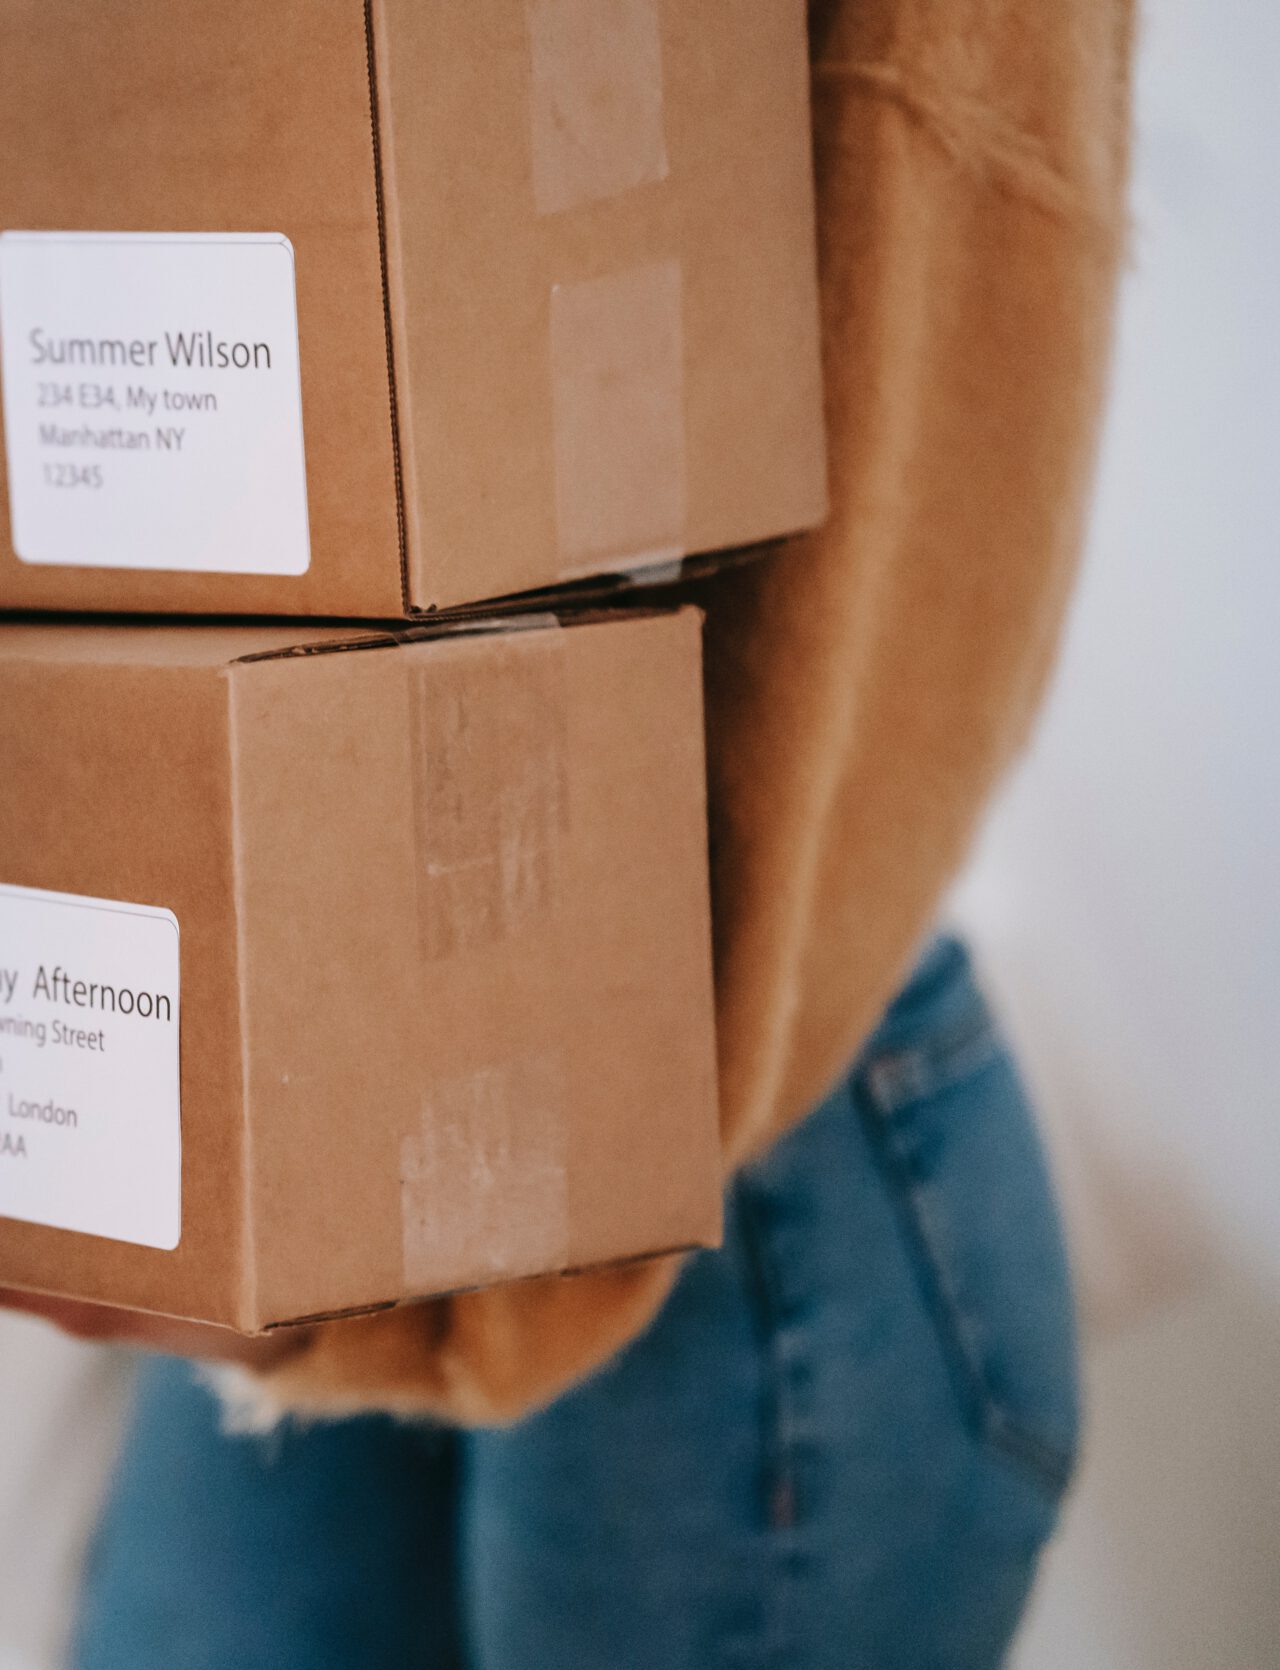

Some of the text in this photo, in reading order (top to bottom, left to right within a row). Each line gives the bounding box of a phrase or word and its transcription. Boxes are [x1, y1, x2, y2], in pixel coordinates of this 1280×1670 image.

[29, 327, 271, 368] Summer Wilson
[37, 383, 72, 408] 234
[127, 386, 157, 416] My
[163, 391, 218, 411] town
[40, 424, 185, 450] Manhattan NY
[43, 463, 103, 488] 12345
[33, 966, 170, 1021] Afternoon
[52, 1019, 105, 1051] Street
[8, 1096, 77, 1127] London
